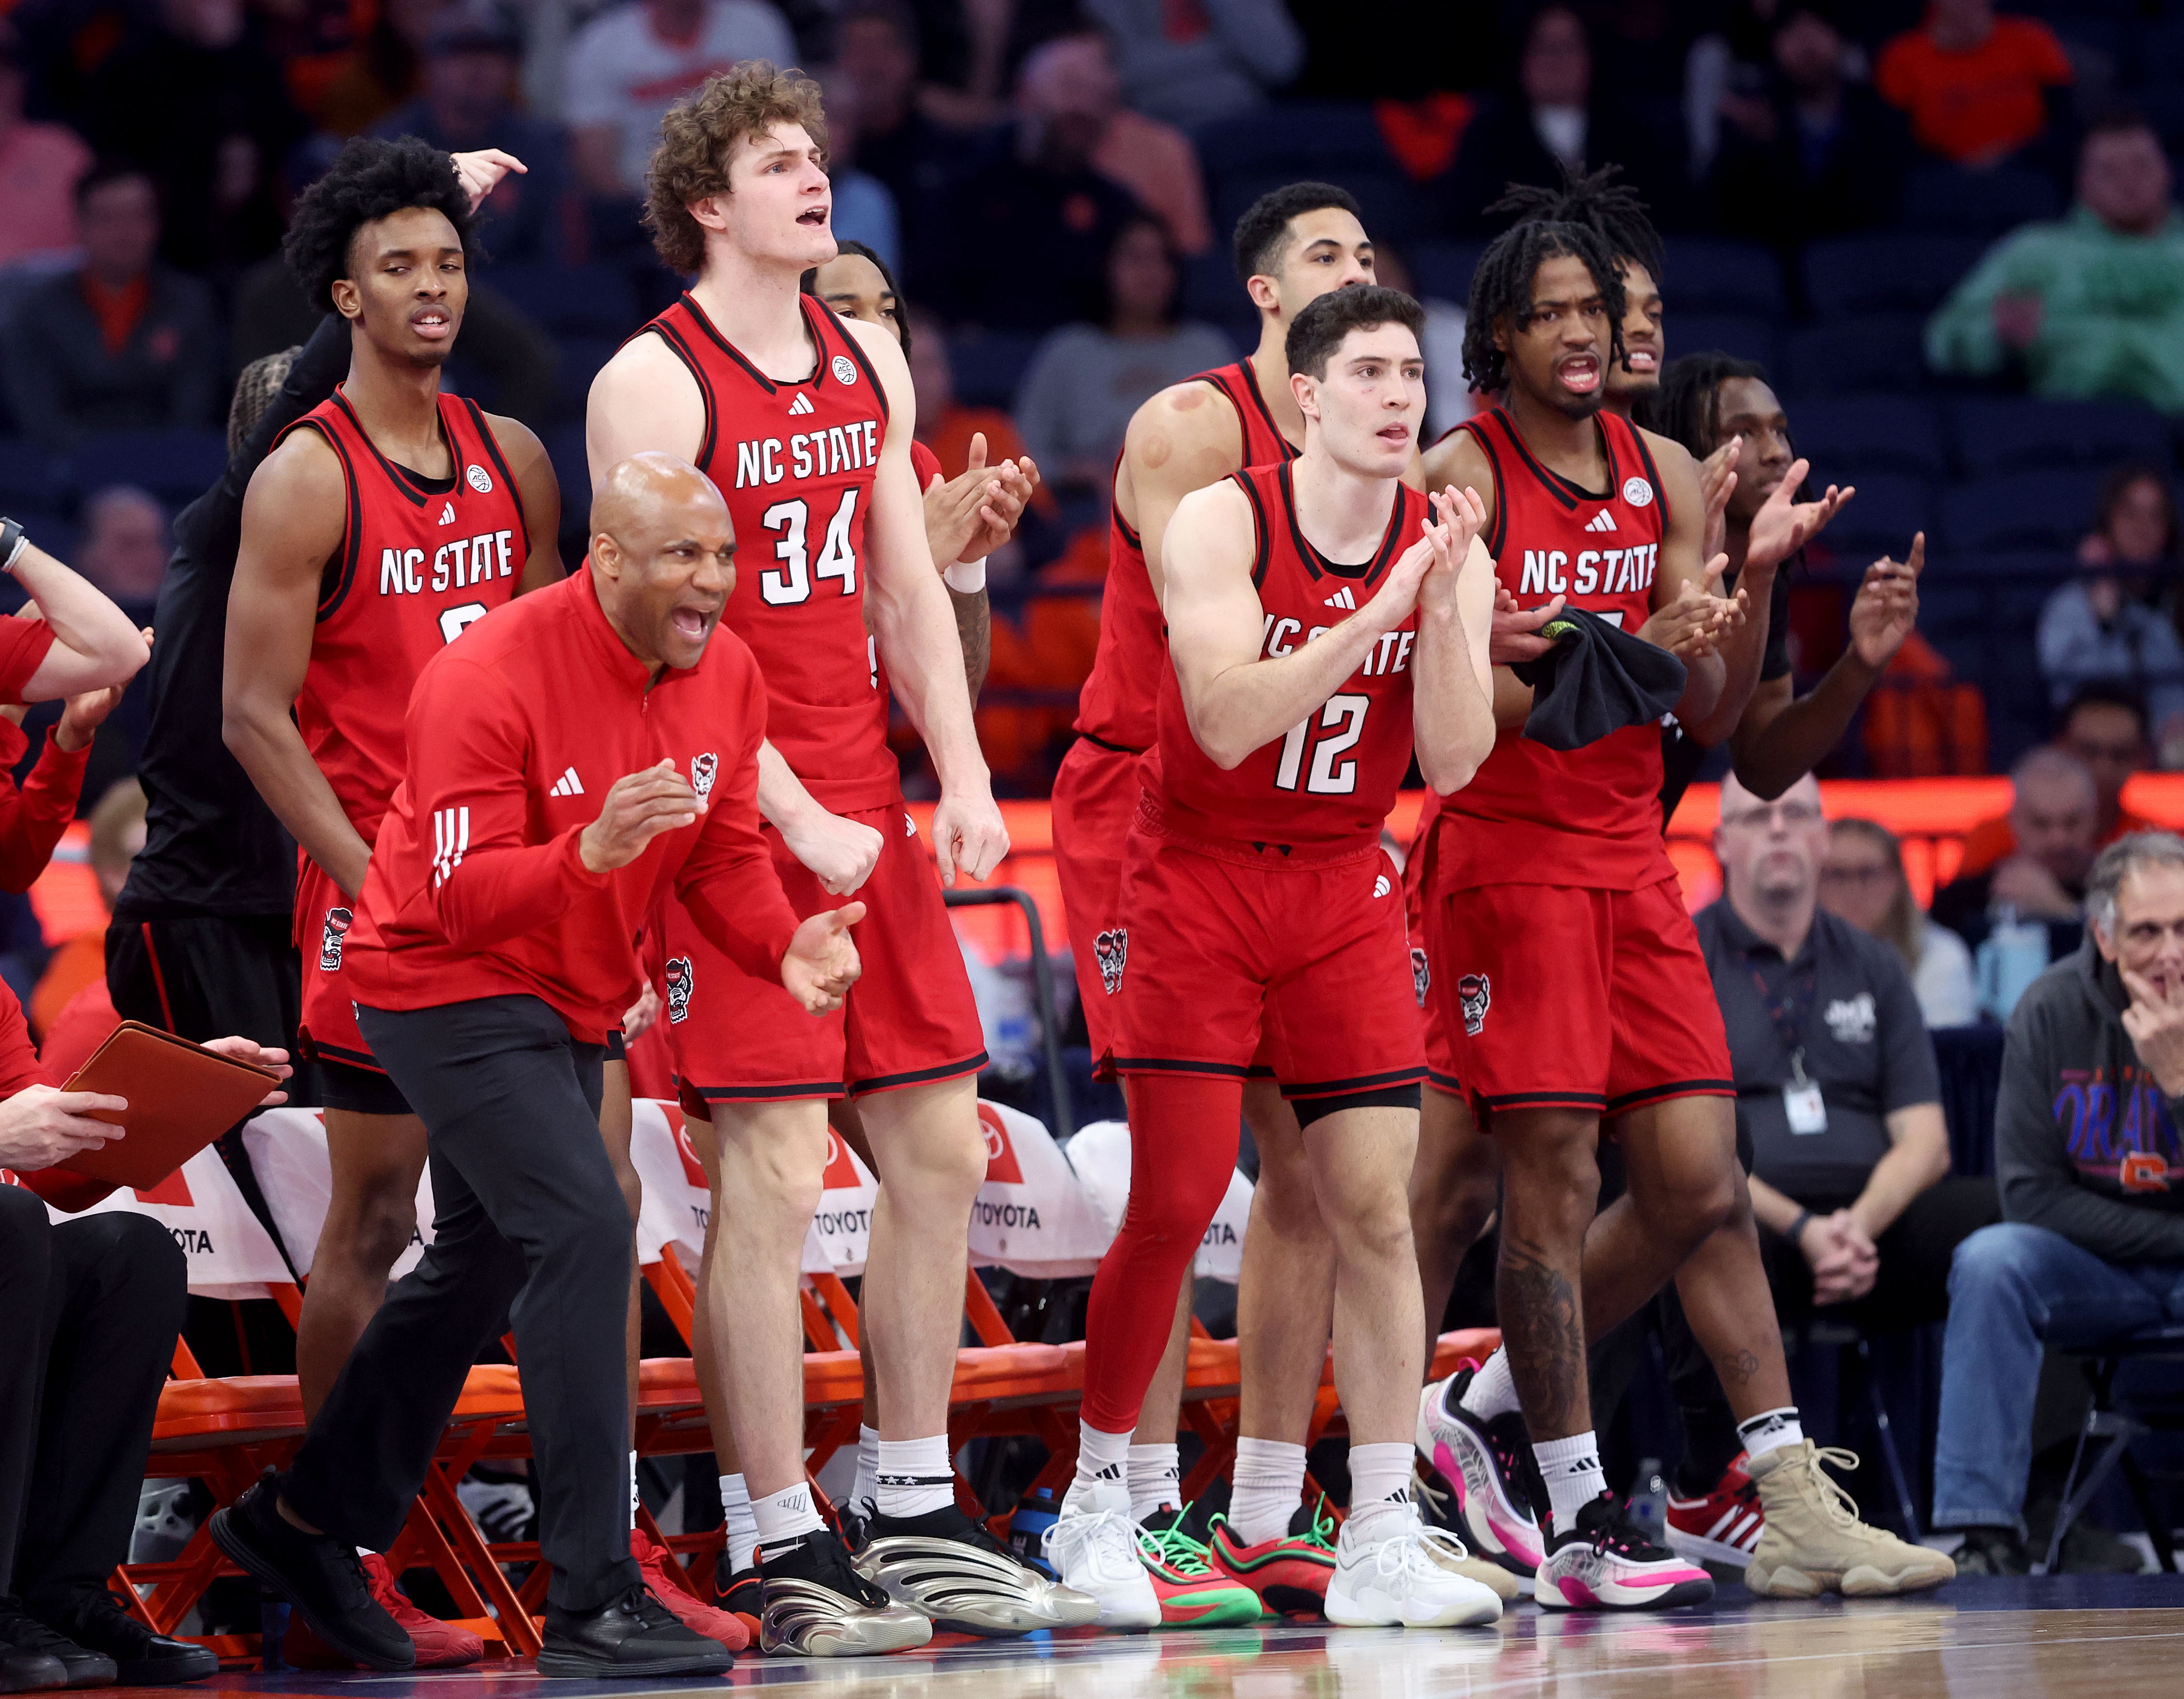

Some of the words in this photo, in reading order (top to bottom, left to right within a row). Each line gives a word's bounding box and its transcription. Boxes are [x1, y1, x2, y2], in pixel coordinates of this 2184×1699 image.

[735, 438, 784, 489] NC
[791, 421, 877, 480] STATE
[380, 548, 426, 595] NC
[431, 530, 513, 592] STATE
[760, 487, 860, 607] 34
[1519, 550, 1568, 594] NC
[1573, 543, 1658, 594] STATE
[1274, 693, 1371, 795] 12
[814, 1209, 873, 1235] TOYOT
[975, 1202, 1040, 1230] TOYOTA
